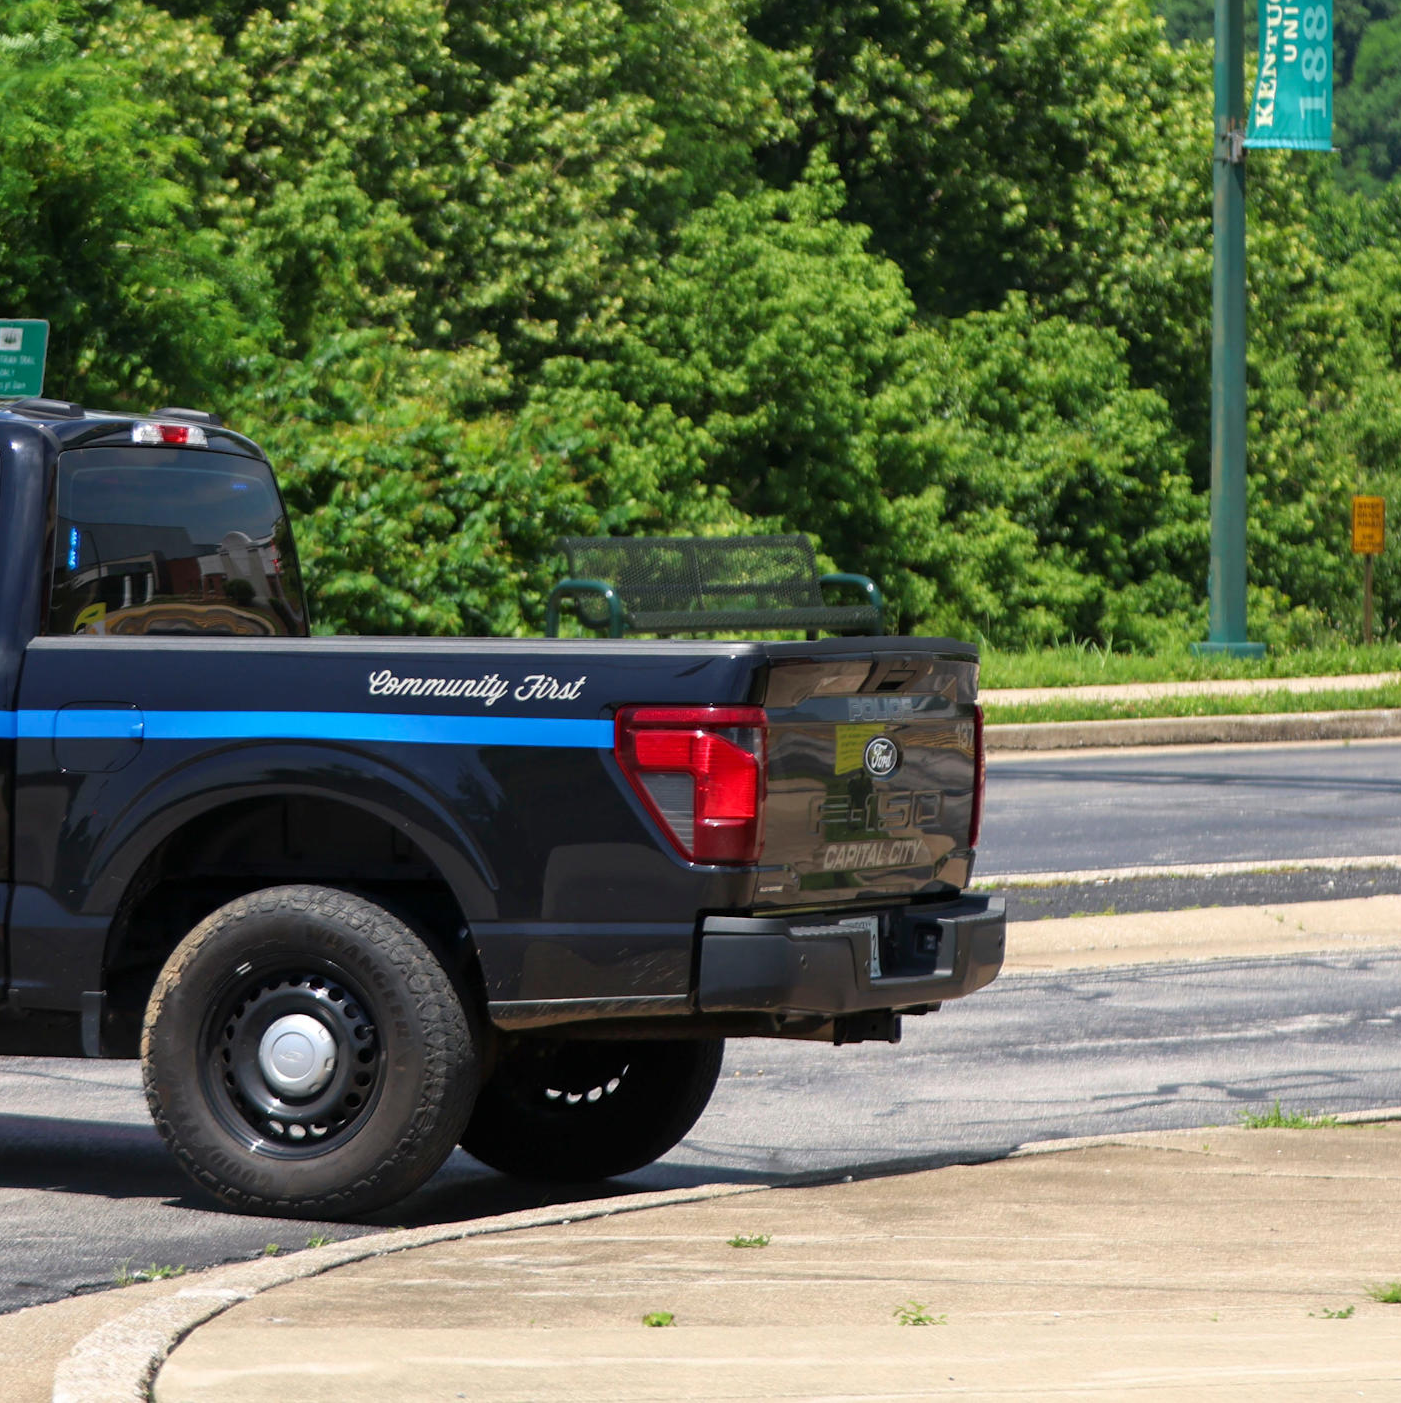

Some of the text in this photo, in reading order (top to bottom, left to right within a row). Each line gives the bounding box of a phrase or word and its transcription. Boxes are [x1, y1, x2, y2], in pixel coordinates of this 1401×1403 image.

[369, 669, 588, 707] Community First
[848, 697, 915, 723] POLICE
[871, 743, 893, 768] Ford
[808, 790, 943, 835] F-150
[823, 839, 923, 870] CAPITAL CITY
